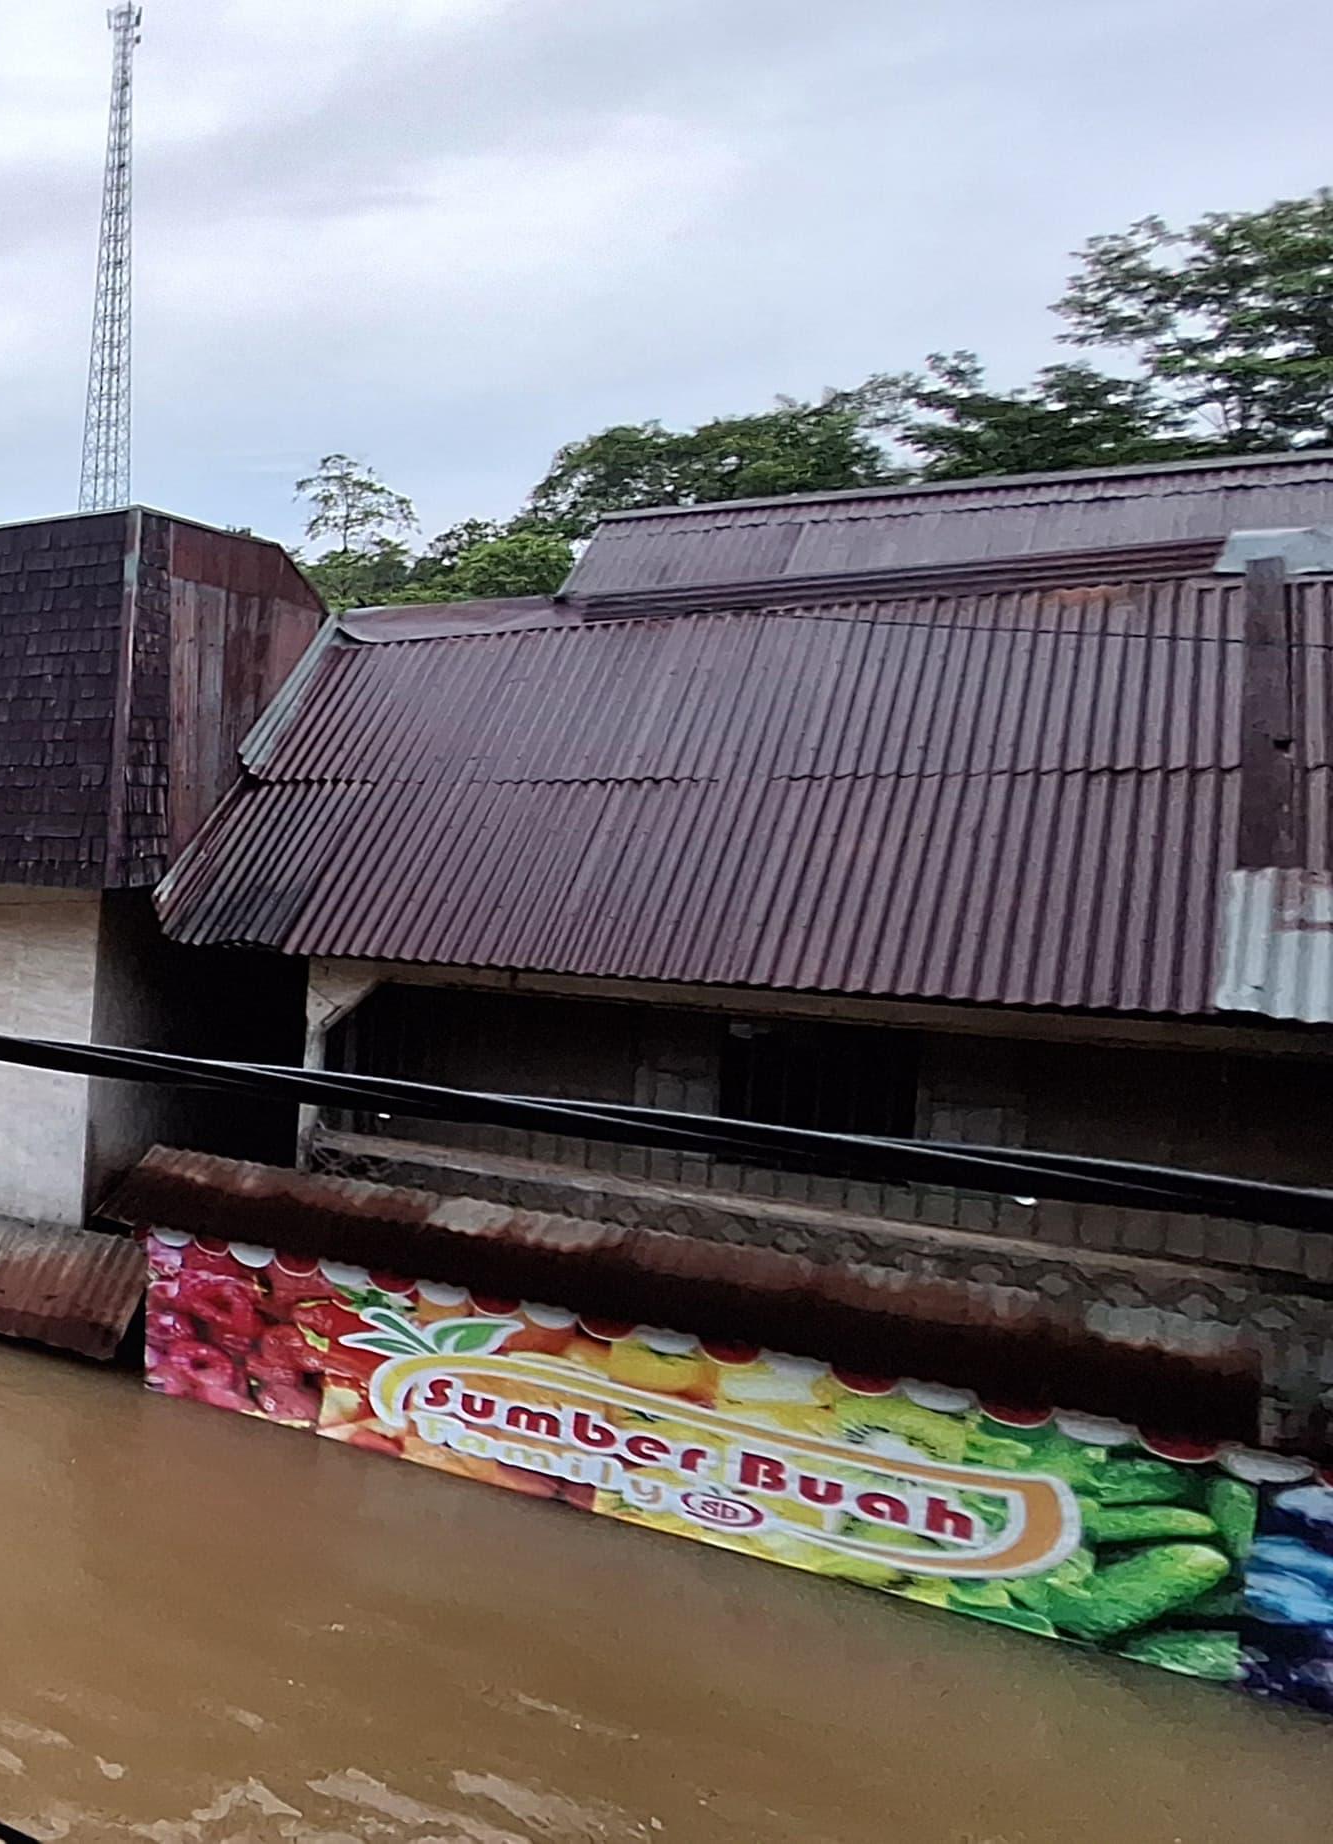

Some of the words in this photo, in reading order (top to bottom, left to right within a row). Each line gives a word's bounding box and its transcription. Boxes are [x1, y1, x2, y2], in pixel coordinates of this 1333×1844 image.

[421, 1417, 663, 1505] Family
[424, 1378, 708, 1473] Sumber
[739, 1451, 974, 1542] Buah
